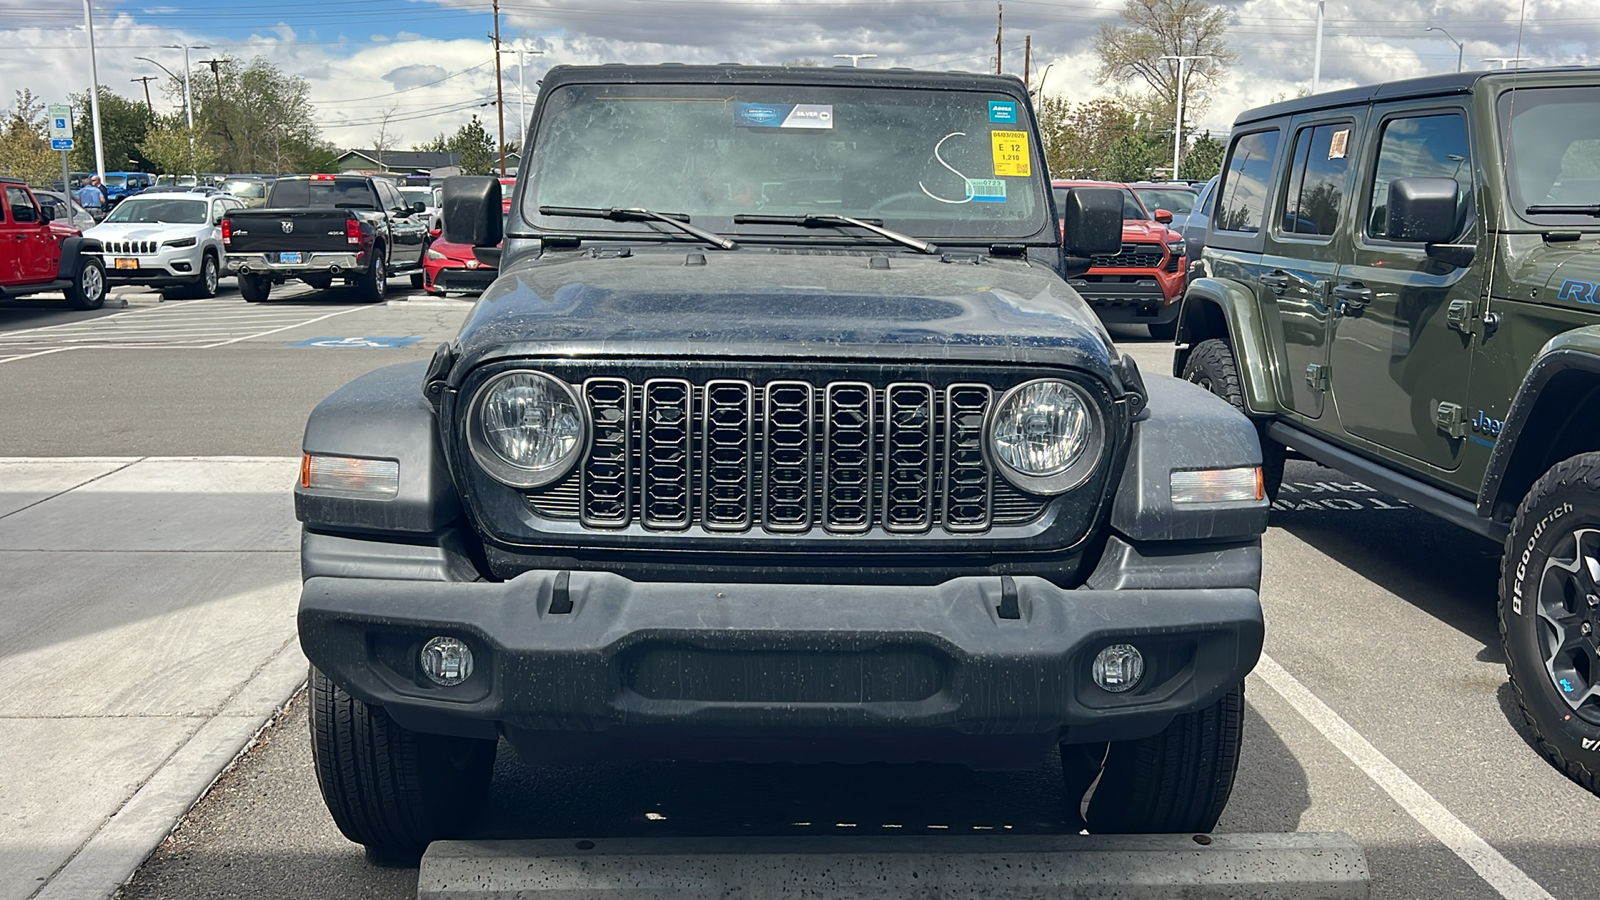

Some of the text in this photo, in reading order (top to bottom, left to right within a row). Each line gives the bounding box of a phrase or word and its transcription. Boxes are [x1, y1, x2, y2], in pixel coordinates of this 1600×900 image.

[999, 144, 1021, 152] E 12
[1512, 501, 1574, 616] BFGoodrich
